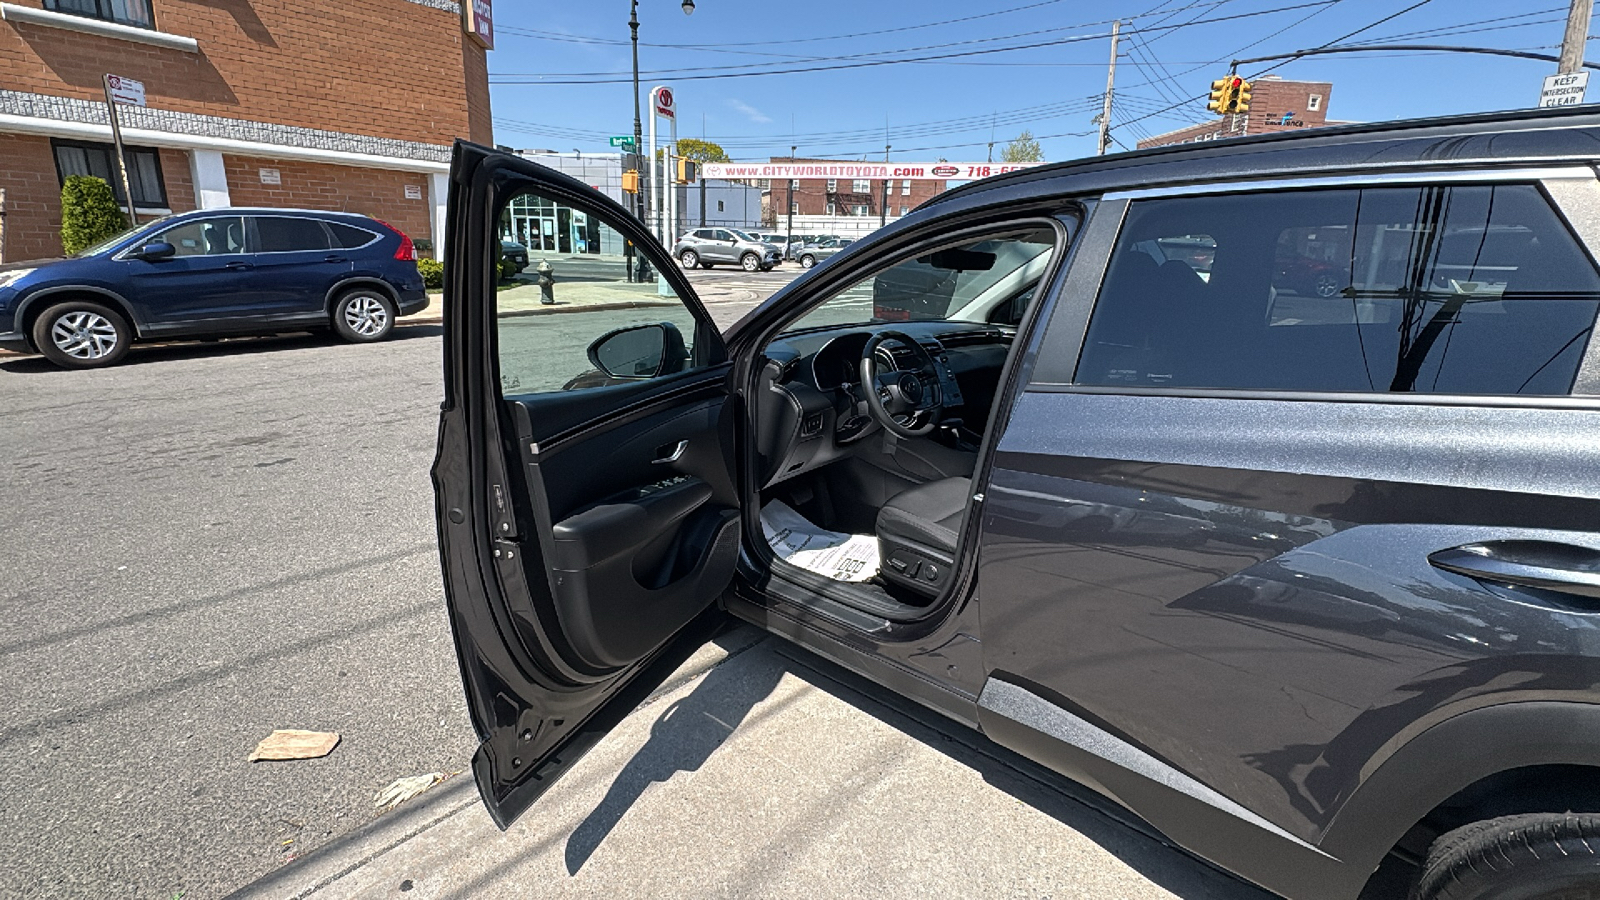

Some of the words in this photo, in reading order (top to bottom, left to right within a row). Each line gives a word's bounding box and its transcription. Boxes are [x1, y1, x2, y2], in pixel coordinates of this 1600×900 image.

[1553, 76, 1578, 87] KEEP
[1542, 86, 1585, 97] INTERSECTION
[1546, 96, 1577, 107] CLEAR
[656, 105, 675, 119] TOYOTA
